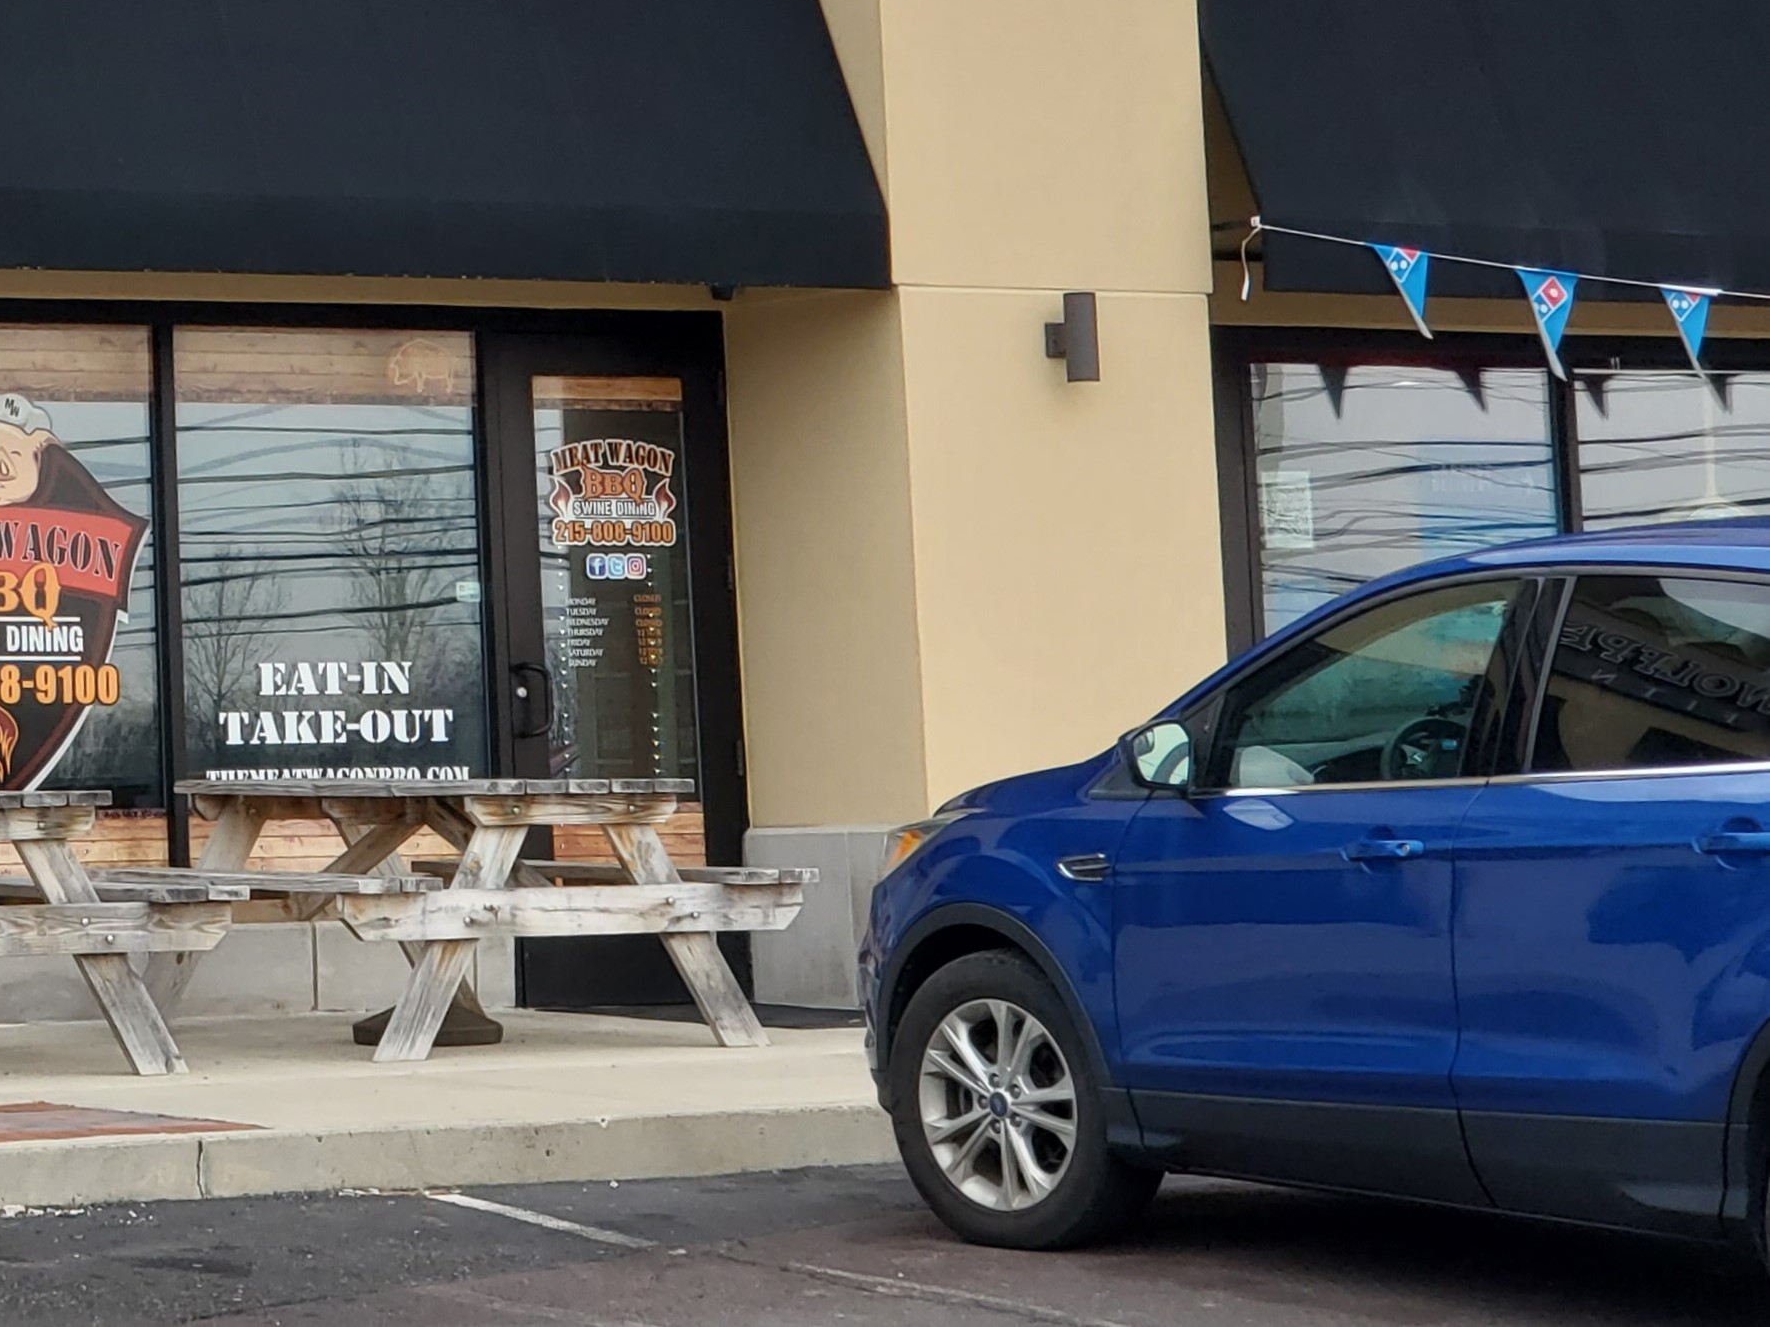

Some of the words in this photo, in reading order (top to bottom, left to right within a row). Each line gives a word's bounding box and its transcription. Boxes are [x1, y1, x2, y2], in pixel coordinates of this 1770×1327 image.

[552, 441, 604, 473] MEAT
[606, 440, 673, 474] WAGON
[580, 463, 646, 505] BBQ
[573, 500, 612, 516] SWINE
[615, 501, 656, 517] DINING
[554, 519, 674, 544] 215-808-9100
[6, 624, 84, 653] DINING
[258, 661, 413, 696] EAT-IN
[218, 709, 454, 745] TAKE-OUT
